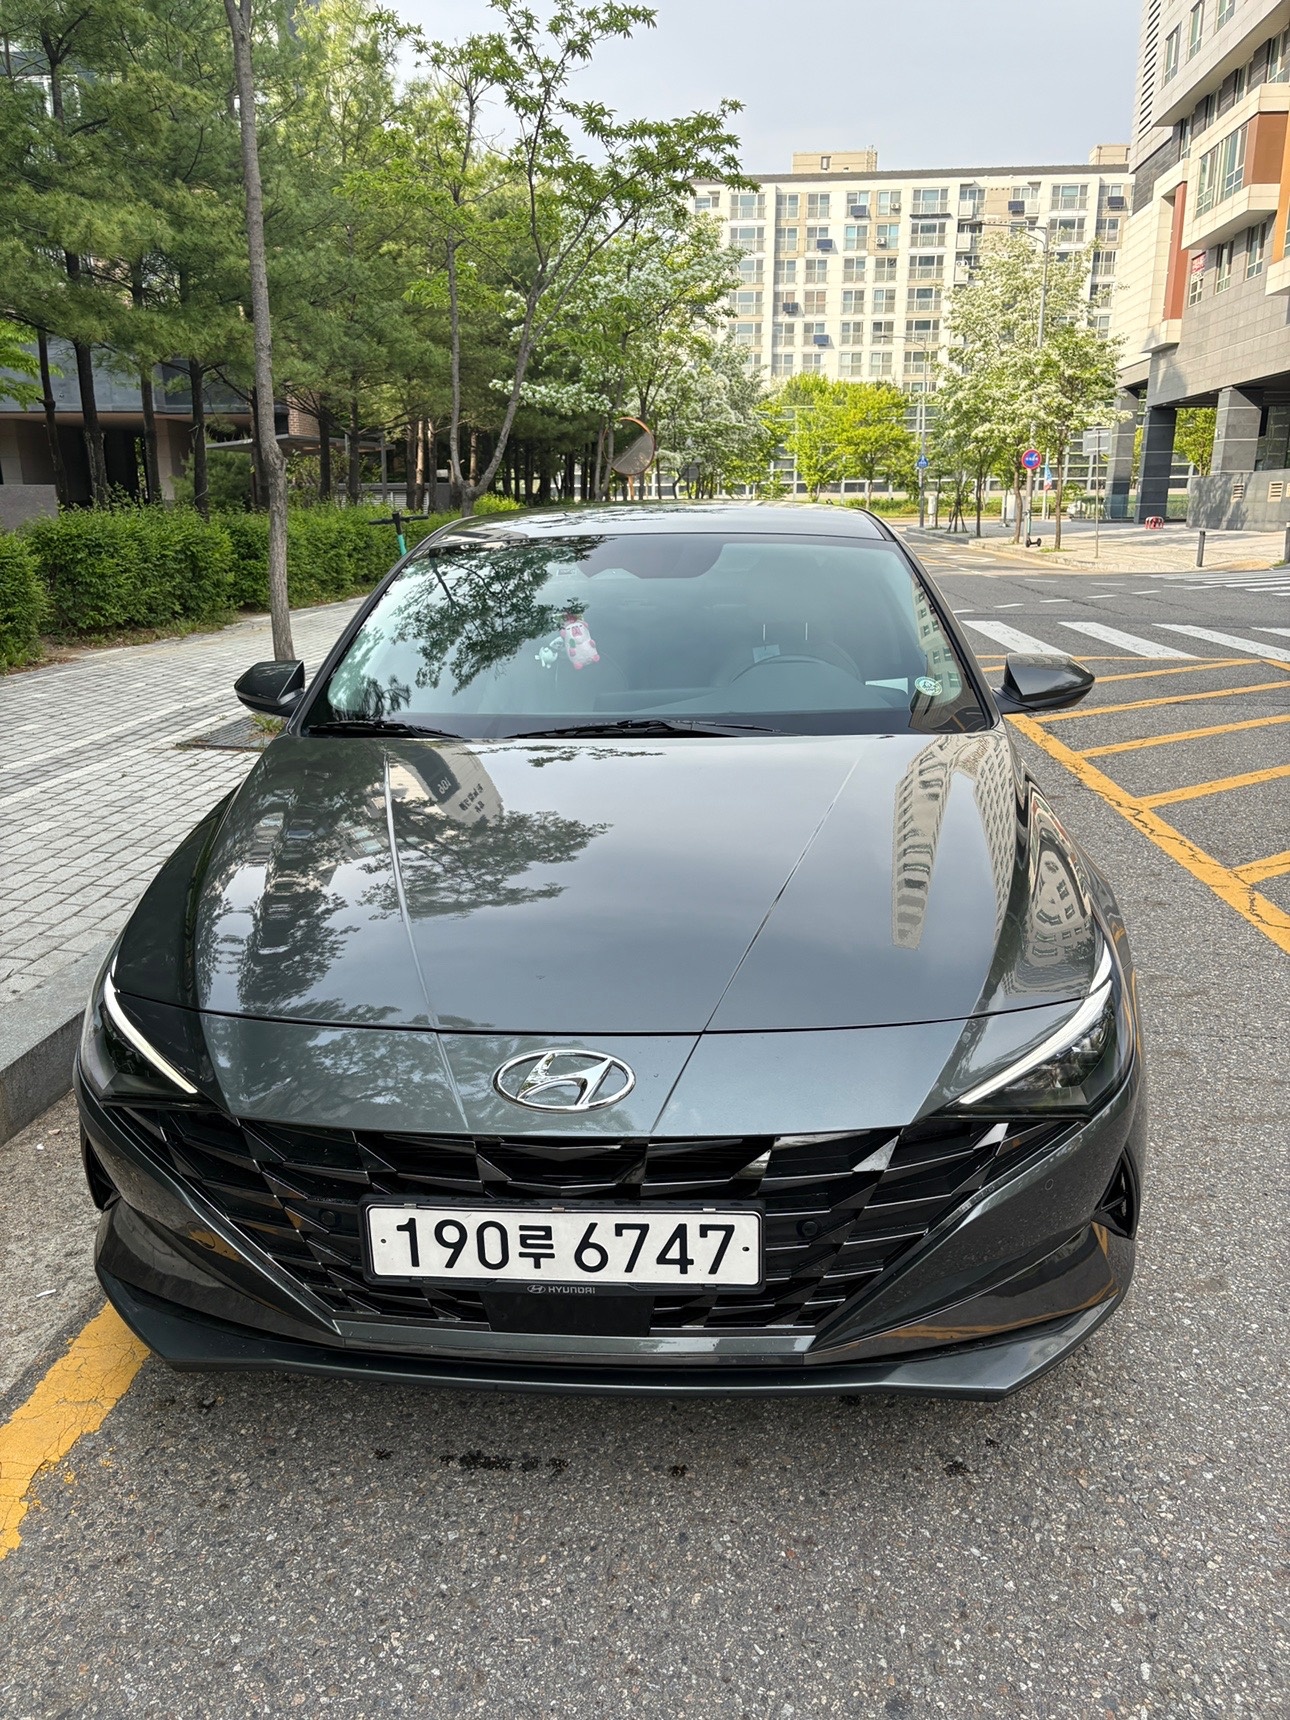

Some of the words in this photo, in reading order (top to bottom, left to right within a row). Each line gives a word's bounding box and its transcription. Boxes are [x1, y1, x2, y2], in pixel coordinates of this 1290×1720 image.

[396, 1217, 556, 1270] 190루
[573, 1222, 735, 1275] 6747
[548, 1286, 596, 1294] HYUNDAI
